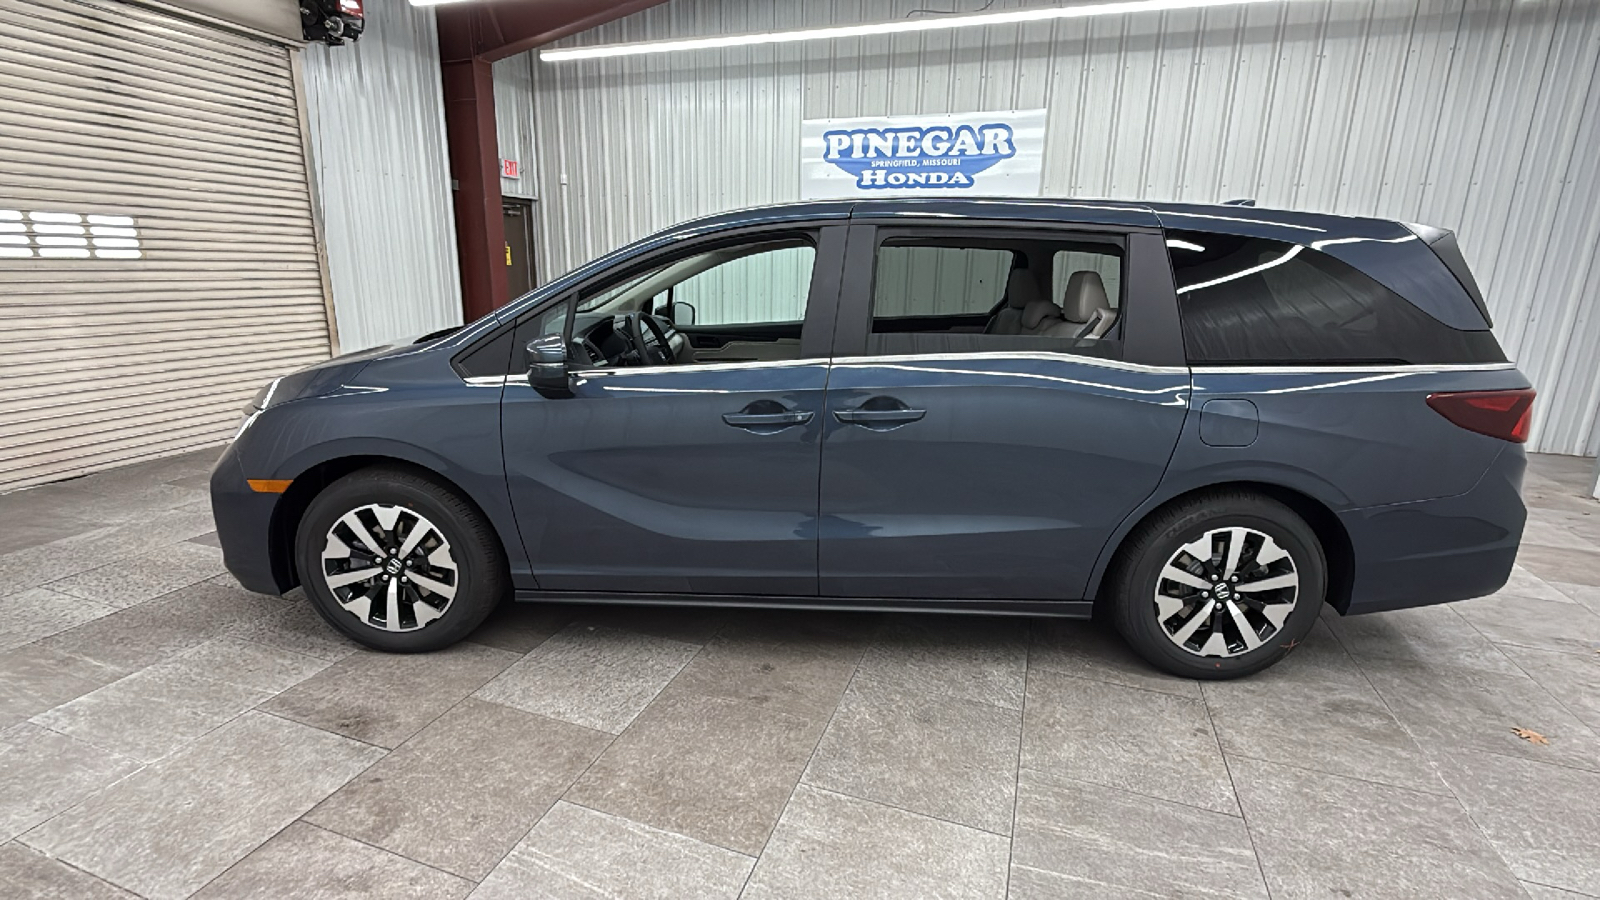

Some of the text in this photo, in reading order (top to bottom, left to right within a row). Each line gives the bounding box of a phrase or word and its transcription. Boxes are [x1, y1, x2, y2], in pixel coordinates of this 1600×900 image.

[827, 127, 1013, 160] PINEGAR
[504, 159, 518, 177] EXIT
[871, 160, 920, 168] SPRINGFIELD,
[861, 169, 970, 186] HONDA
